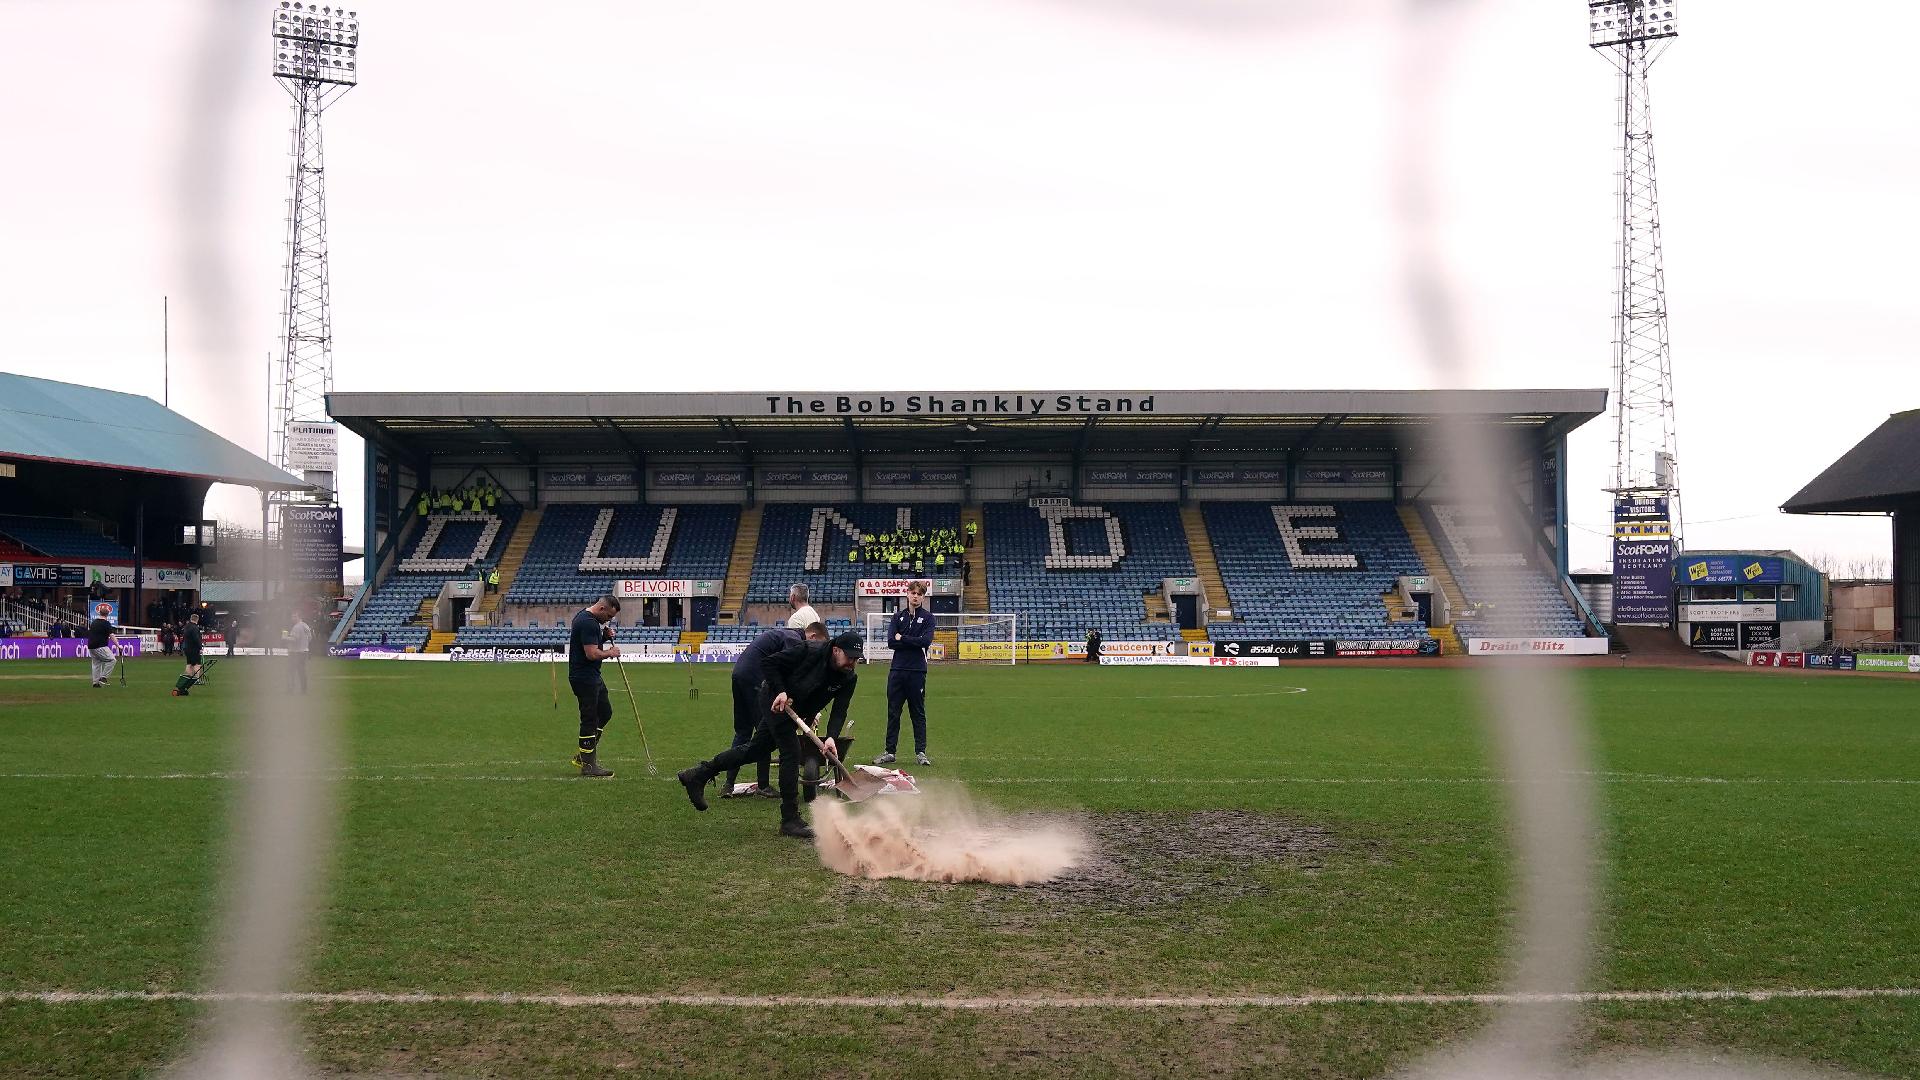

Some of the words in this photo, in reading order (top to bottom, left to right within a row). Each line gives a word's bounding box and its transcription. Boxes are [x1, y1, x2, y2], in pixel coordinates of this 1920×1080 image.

[766, 397, 825, 414] The
[836, 397, 895, 413] Bob
[906, 396, 1045, 415] Shankly
[1056, 396, 1154, 412] Stand
[289, 510, 338, 521] ScotFOAM
[1617, 544, 1668, 555] ScotFOAM
[0, 568, 10, 576] AY
[104, 571, 145, 584] bartercad
[624, 580, 686, 592] BELVOIR!
[0, 641, 20, 660] inch
[36, 638, 62, 658] cinch
[75, 638, 92, 658] cin
[1250, 644, 1299, 654] assai.co.uk
[1480, 641, 1519, 651] Drain
[1532, 641, 1565, 651] Blitz
